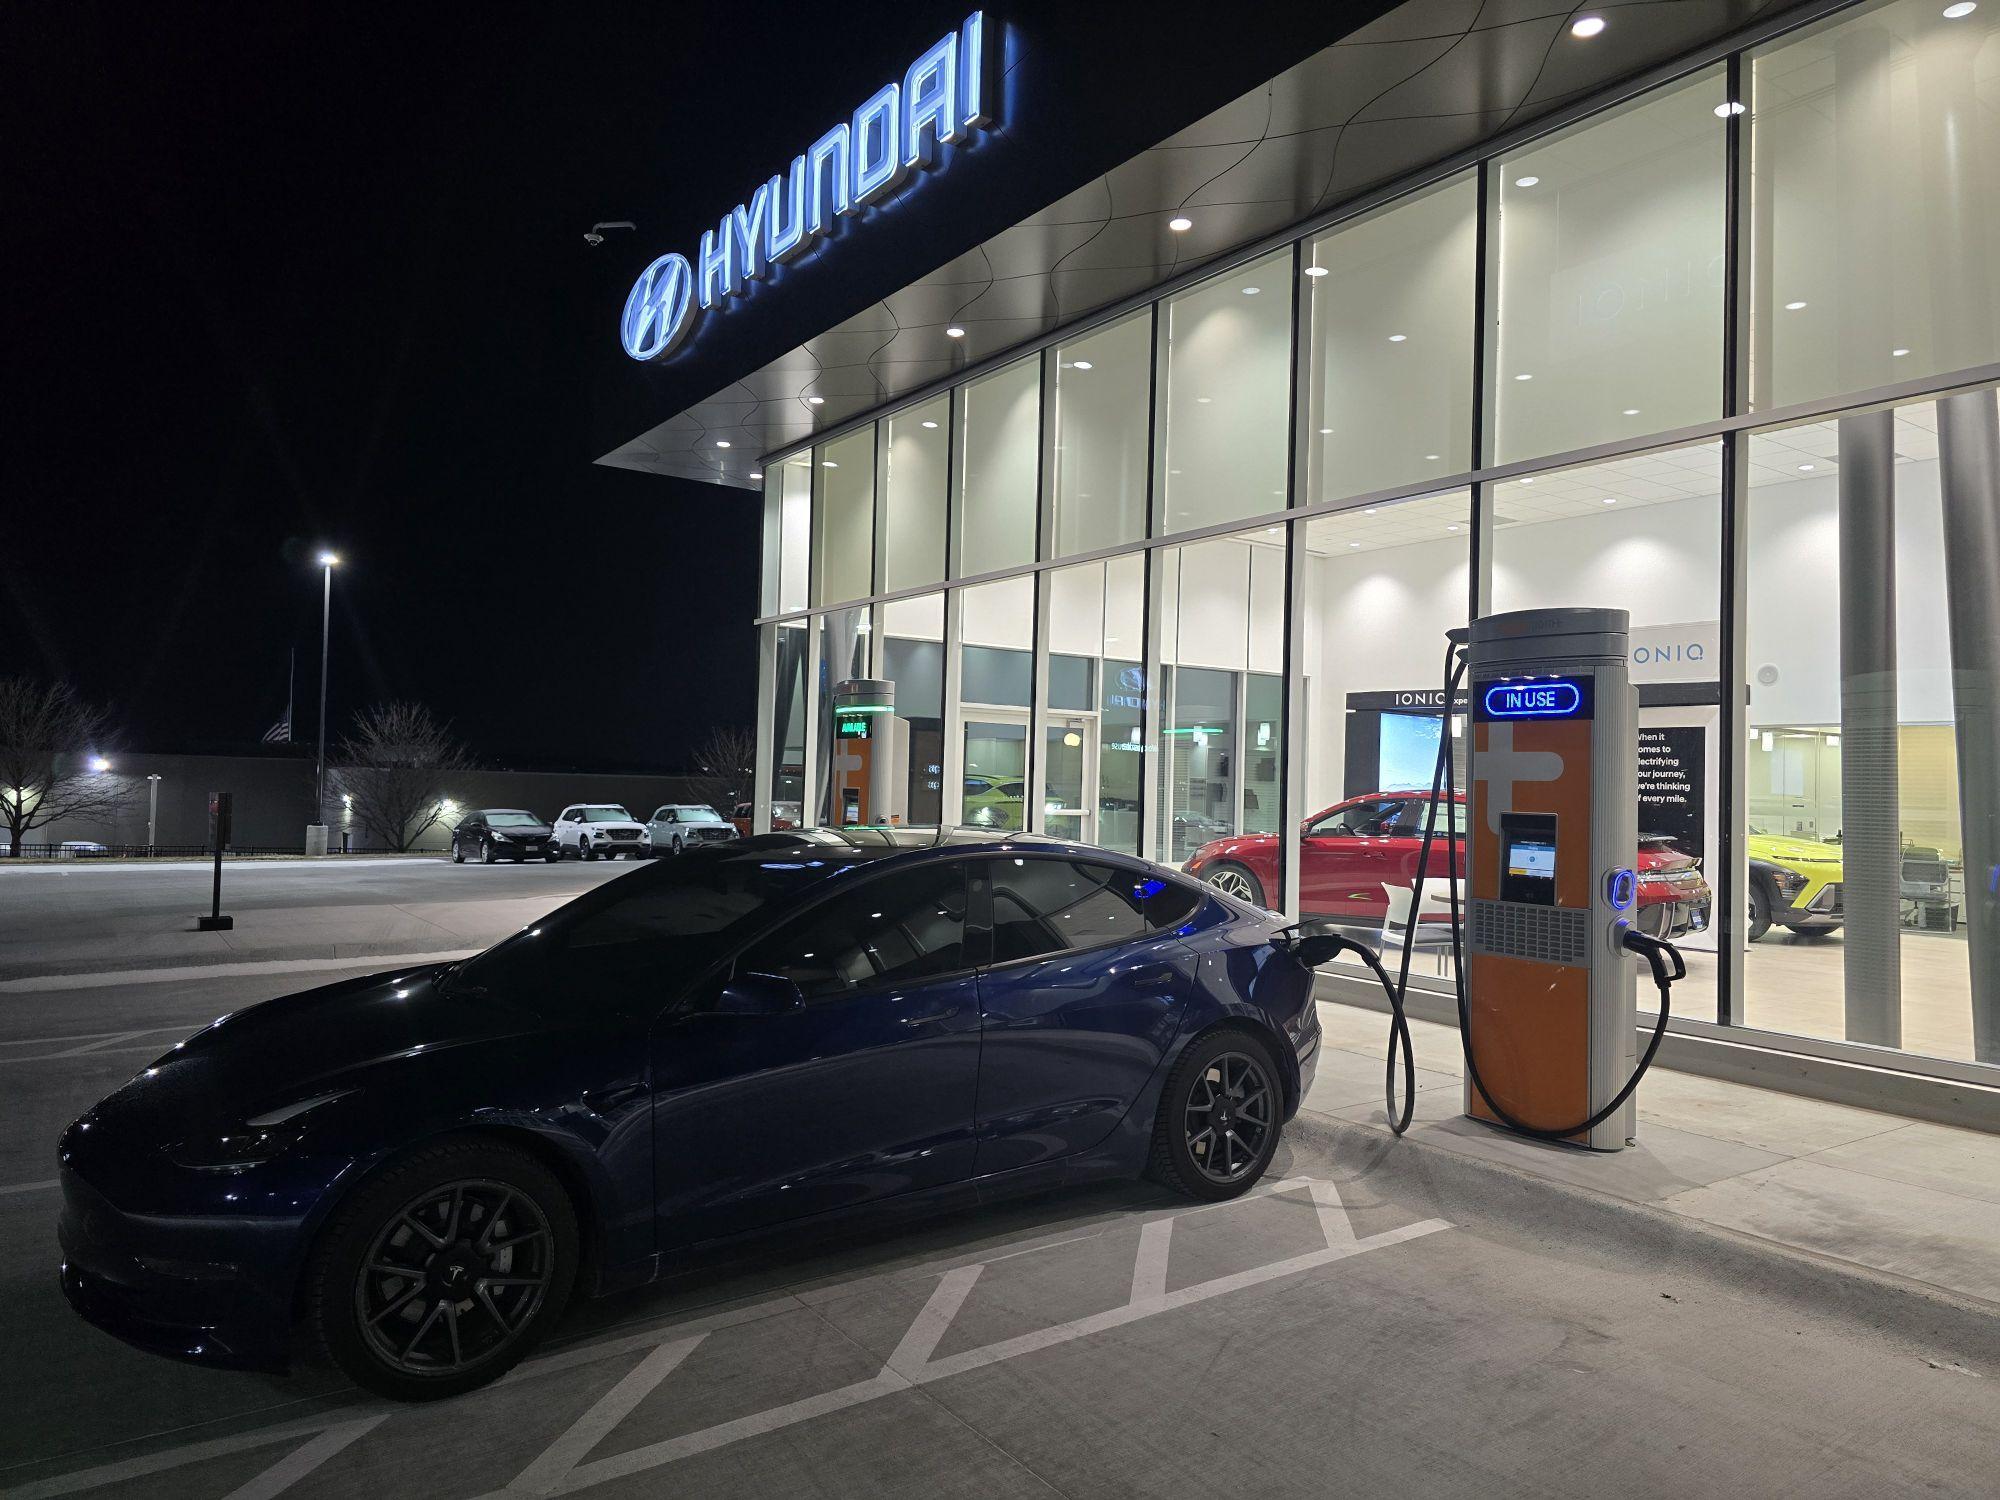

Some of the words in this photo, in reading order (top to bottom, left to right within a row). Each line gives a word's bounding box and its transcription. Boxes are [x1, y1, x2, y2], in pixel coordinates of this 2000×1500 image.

[699, 9, 984, 311] HYUNDAI
[1633, 643, 1704, 664] ONIQ
[1506, 692, 1522, 708] IN
[1524, 691, 1556, 708] USE
[1659, 733, 1665, 741] it
[1638, 757, 1679, 767] lectrifying
[1652, 770, 1686, 779] journey,
[1638, 782, 1655, 790] e're
[1656, 782, 1691, 792] thinking
[1642, 795, 1665, 804] every
[1666, 794, 1687, 803] mile.
